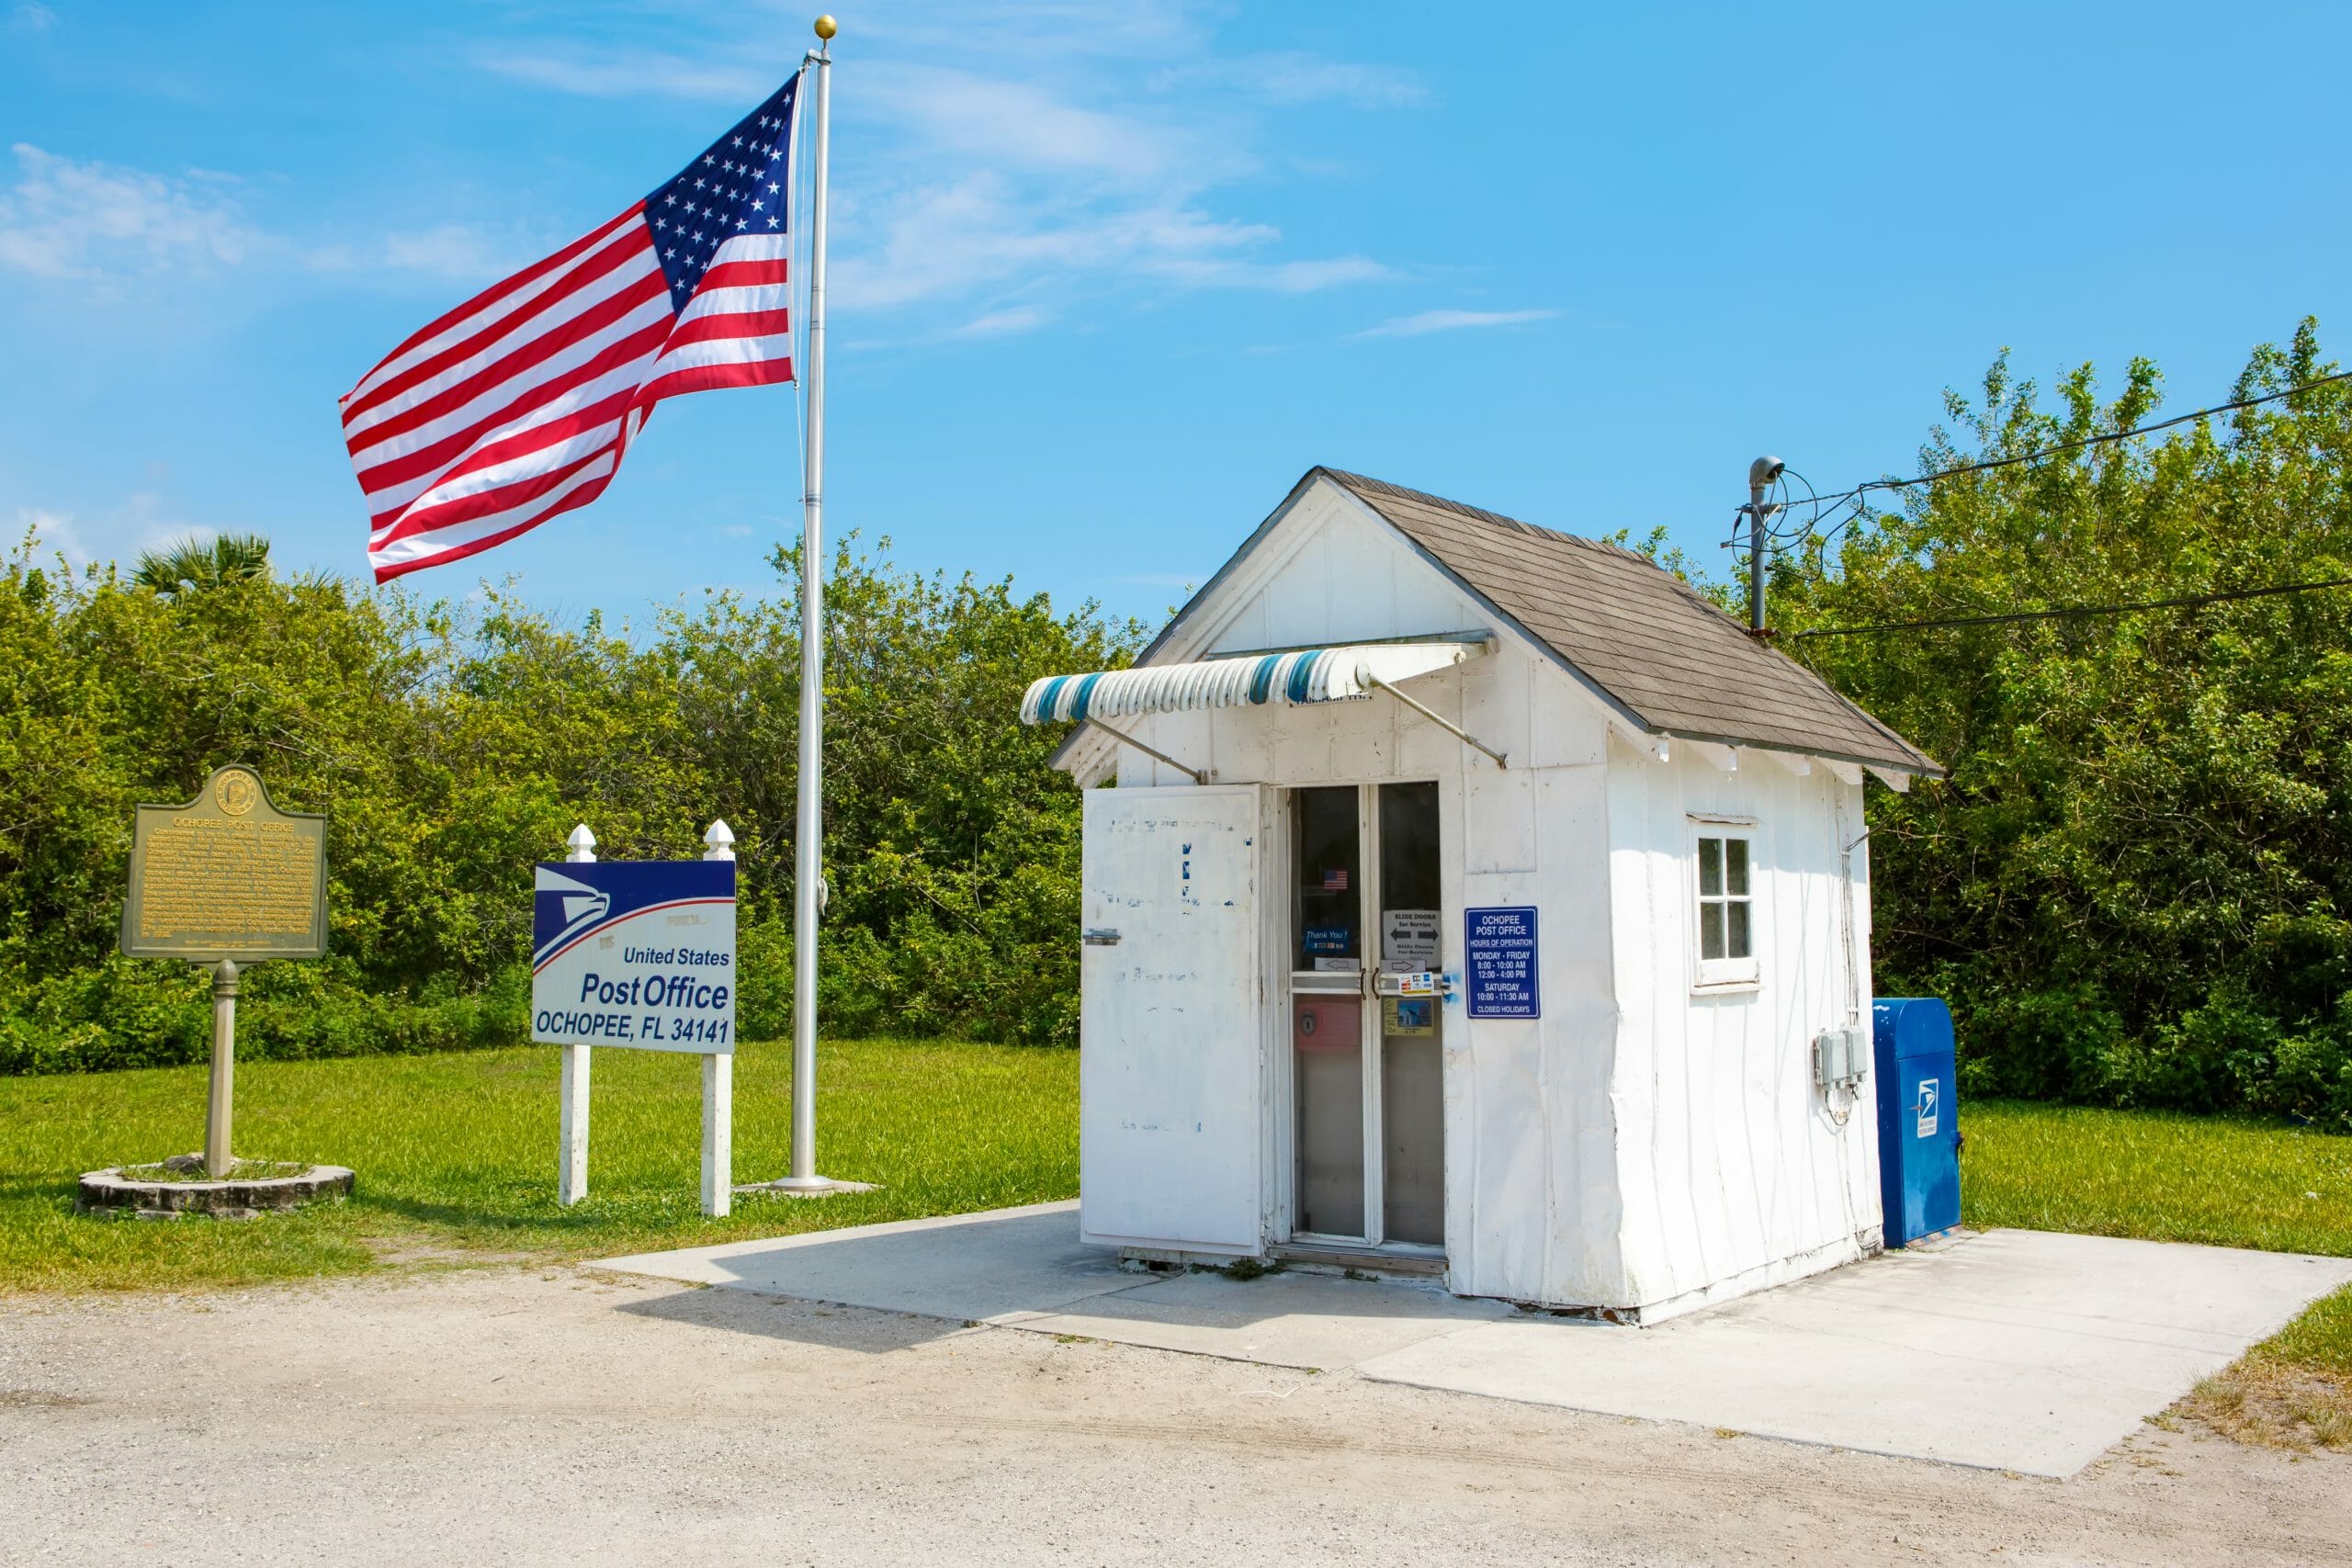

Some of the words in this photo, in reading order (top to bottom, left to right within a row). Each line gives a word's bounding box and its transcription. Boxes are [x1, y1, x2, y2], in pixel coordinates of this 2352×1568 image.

[173, 817, 222, 829] OCHOPEE
[228, 820, 254, 830] POST
[260, 821, 294, 832] OFFICE
[1482, 915, 1520, 925] OCHOPEE
[1476, 926, 1497, 935] POST
[1498, 925, 1526, 935] OFFICE
[1306, 931, 1328, 939] Thank
[1329, 931, 1342, 939] You
[1470, 939, 1490, 947] HOURS
[624, 947, 675, 964] United
[677, 948, 729, 965] States
[1473, 952, 1501, 960] MONDAY
[1507, 951, 1531, 960] FRIDAY
[1477, 961, 1491, 969] 8:00
[1497, 961, 1514, 969] 10:00
[1515, 961, 1526, 969] AM
[1500, 970, 1514, 978] 4:00
[1515, 970, 1526, 978] PM
[581, 973, 640, 1005] Post
[643, 975, 729, 1010] Office
[1485, 983, 1520, 991] SATURDAY
[1477, 993, 1494, 1001] 10:00
[1499, 992, 1517, 1000] 11:30
[1518, 992, 1529, 1000] AM
[1501, 1005, 1530, 1013] HOLIDAYS
[537, 1010, 634, 1042] OCHOPEE,
[641, 1017, 665, 1040] FL
[671, 1018, 729, 1043] 34141
